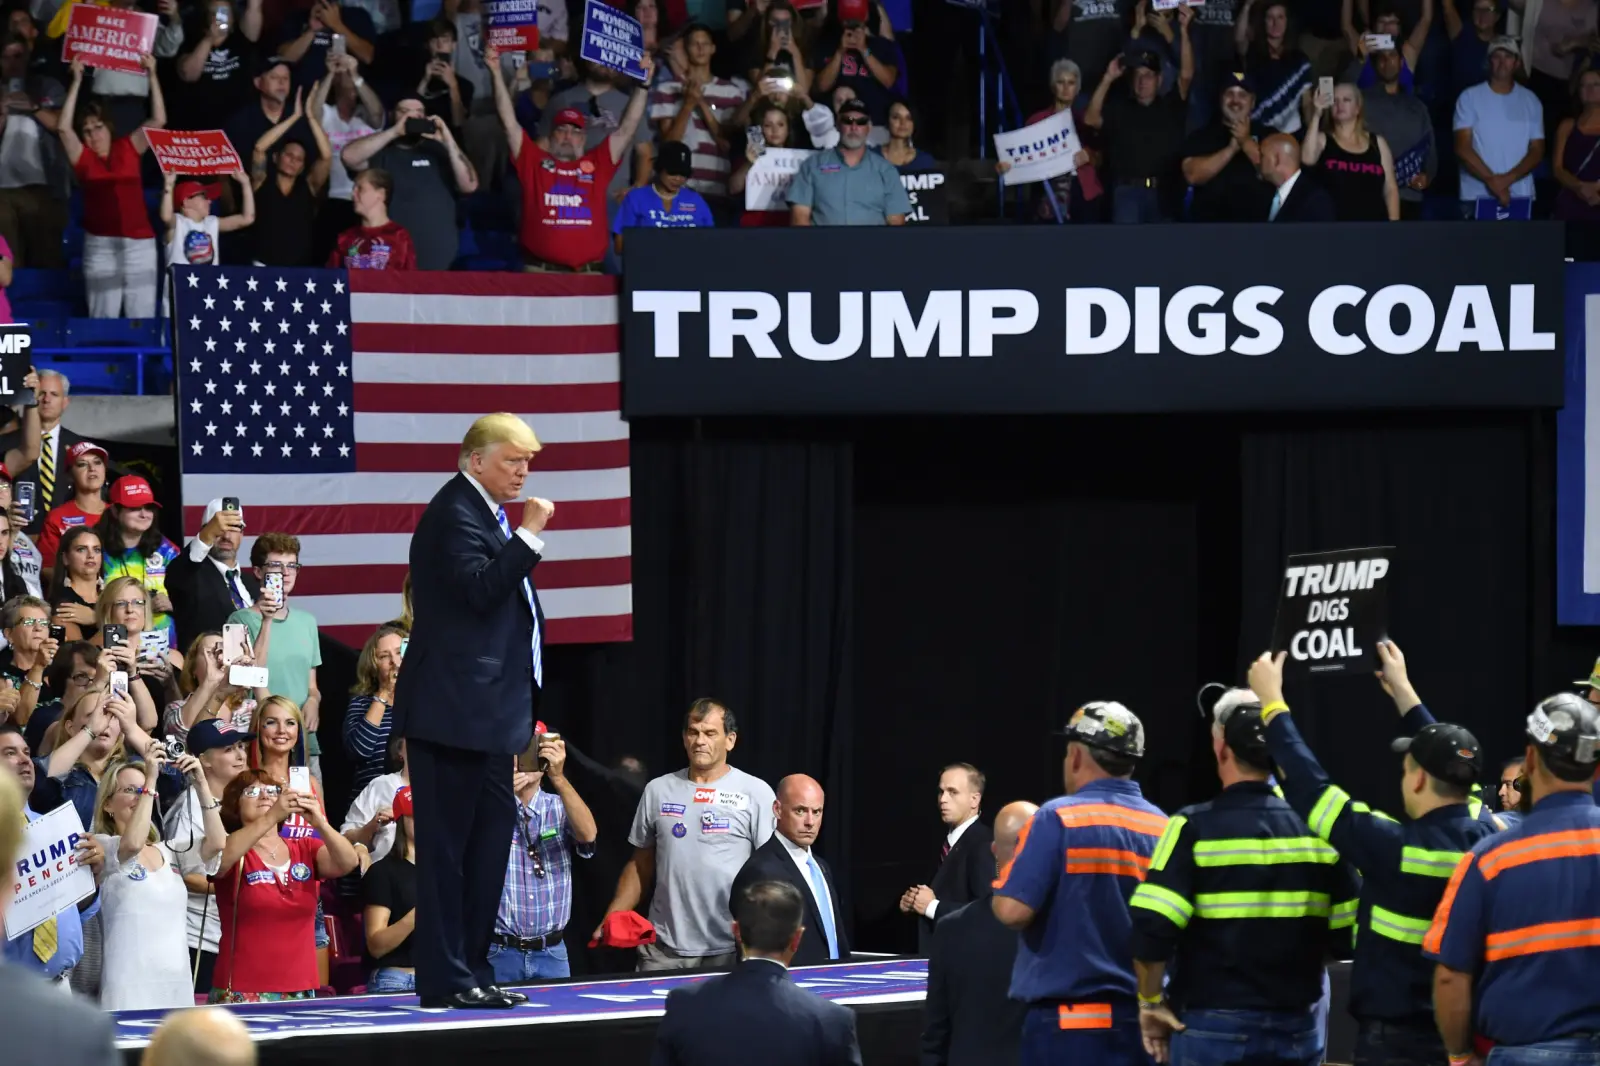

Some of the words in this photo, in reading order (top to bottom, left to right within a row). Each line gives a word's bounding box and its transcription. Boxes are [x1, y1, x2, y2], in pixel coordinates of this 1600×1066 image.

[591, 7, 640, 37] PROMISES
[602, 23, 632, 43] MADE
[69, 25, 149, 53] AMERICA
[589, 33, 643, 62] PROMISES
[600, 48, 629, 68] KEPT
[155, 144, 233, 158] AMERICA
[1005, 128, 1070, 157] TRUMP
[160, 156, 198, 167] PROUD
[200, 155, 236, 167] AGAIN
[1325, 158, 1384, 176] TRUMP
[544, 192, 583, 207] TRUMP
[904, 206, 930, 221] AL
[632, 288, 1040, 361] TRUMP
[1065, 285, 1285, 356] DIGS
[1307, 283, 1556, 356] COAL
[1285, 558, 1390, 597] TRUMP
[1307, 597, 1350, 623] DIGS
[1290, 627, 1363, 661] COAL
[289, 826, 314, 838] THE
[16, 832, 81, 878] RUMP
[14, 853, 76, 894] PENCE
